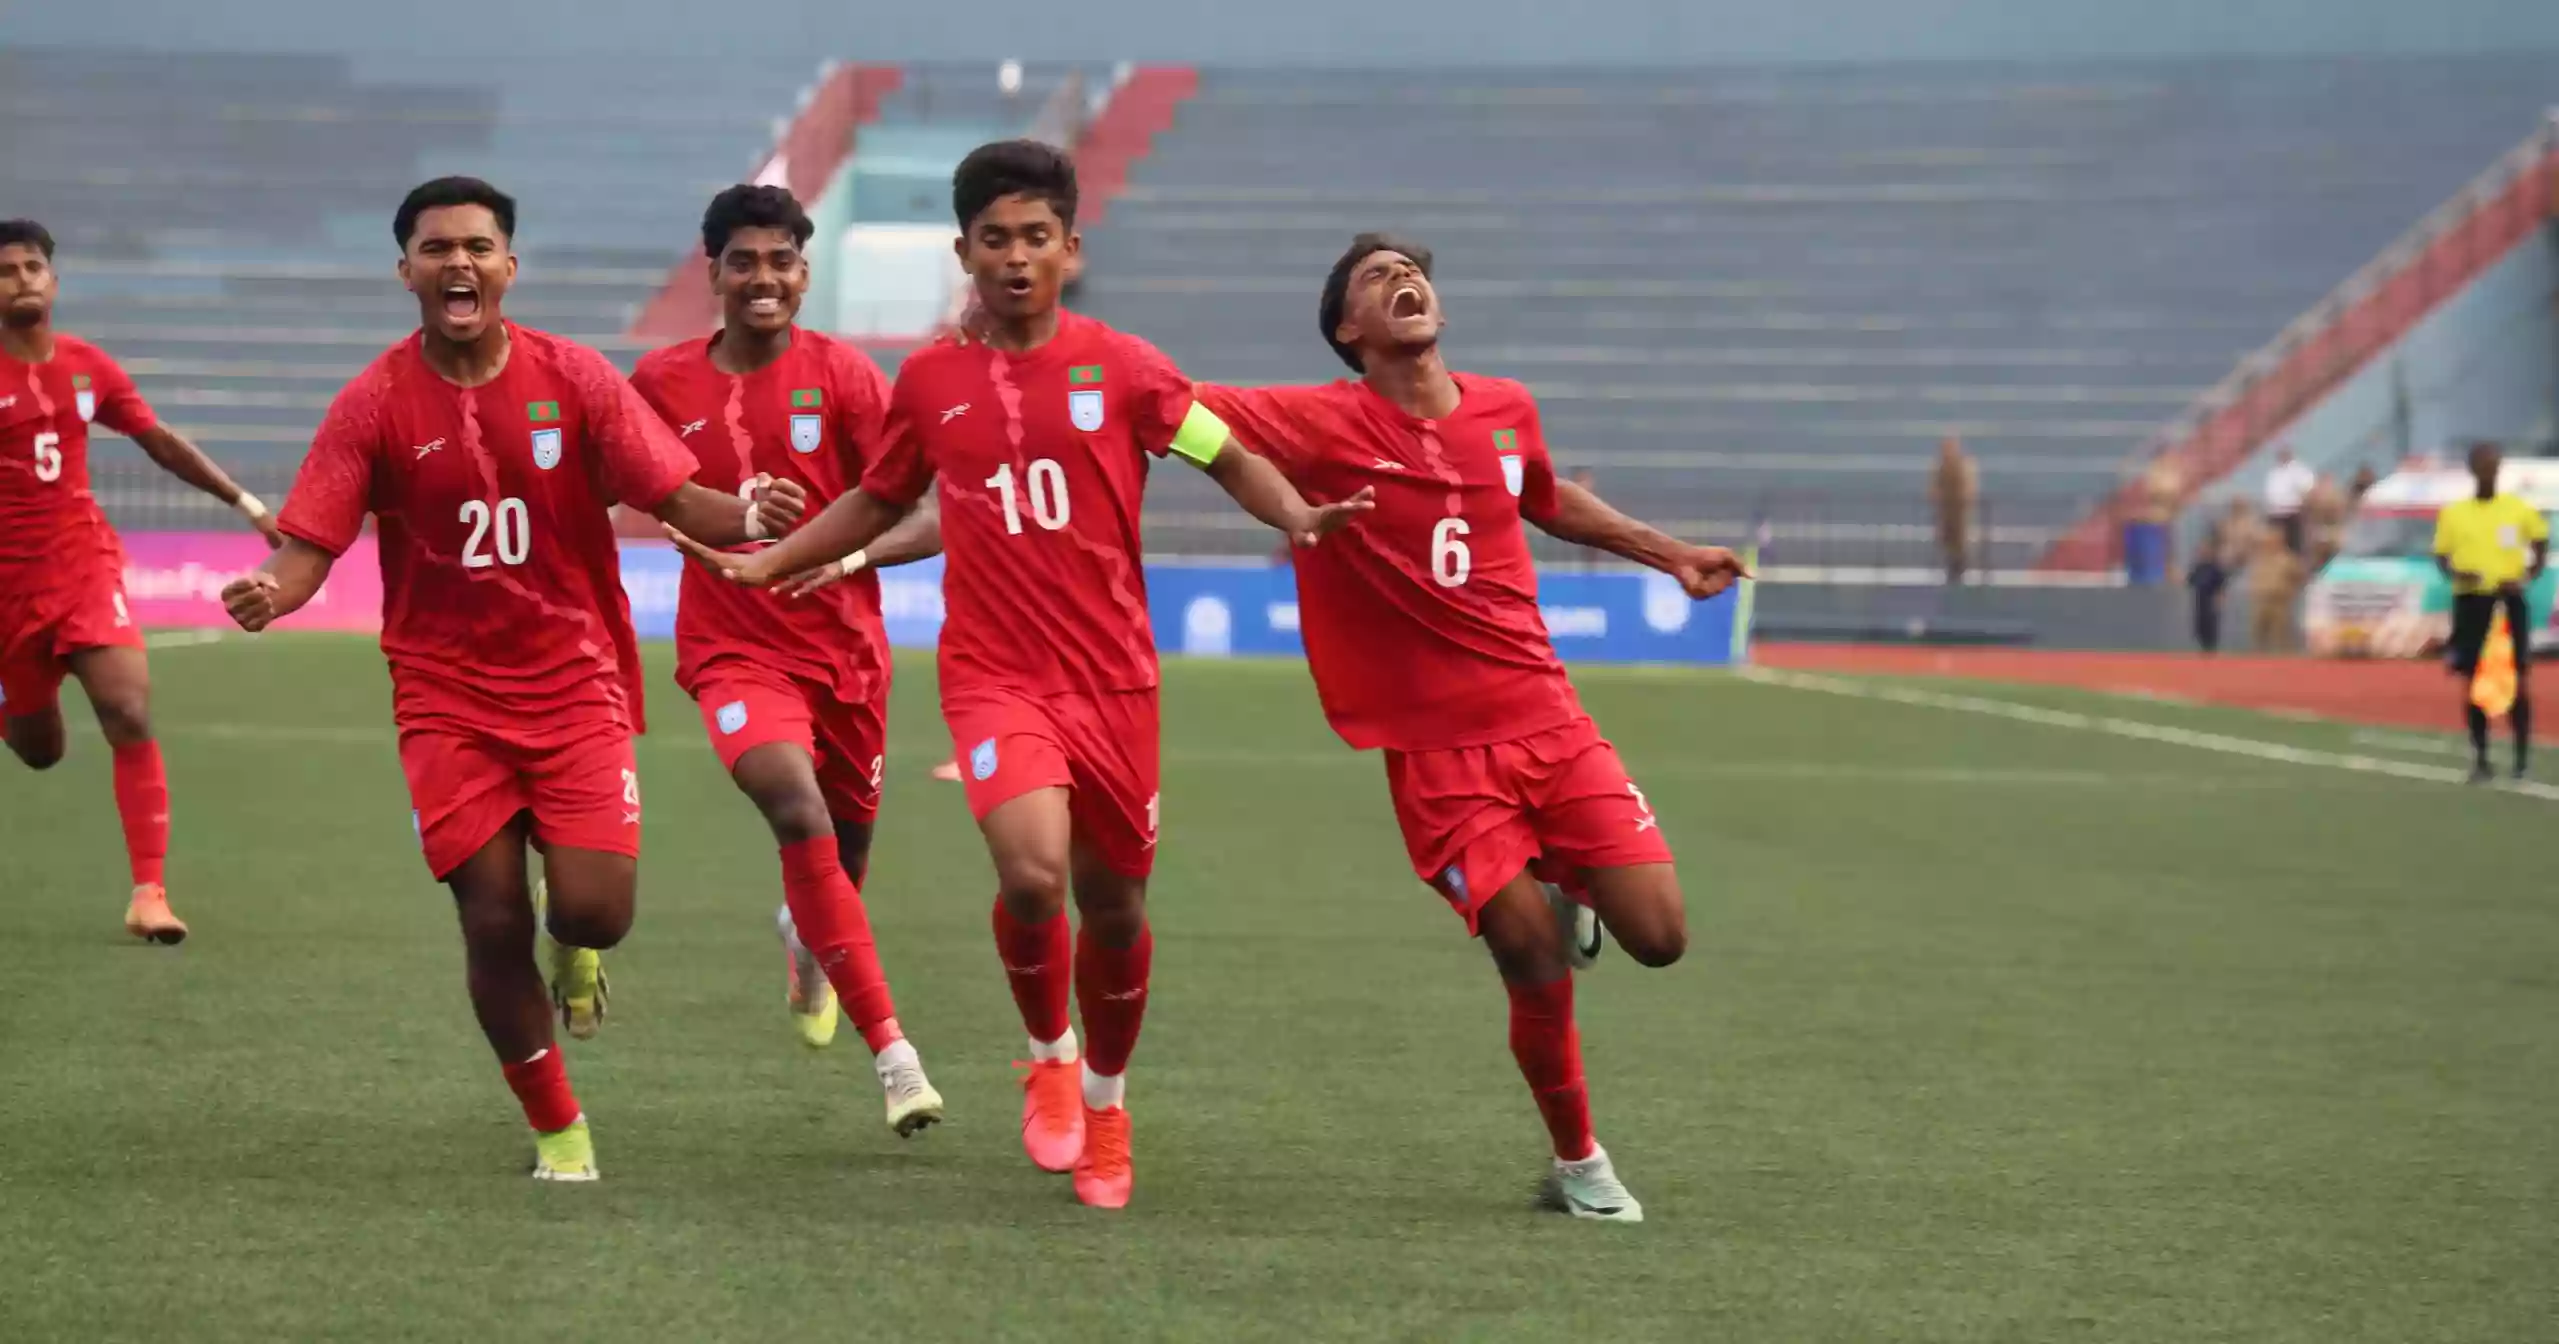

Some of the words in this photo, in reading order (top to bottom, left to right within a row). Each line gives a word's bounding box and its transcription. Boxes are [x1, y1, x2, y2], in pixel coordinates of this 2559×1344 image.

[34, 432, 62, 482] 5
[986, 459, 1069, 534] 10
[459, 497, 531, 567] 20
[1431, 517, 1471, 588] 6
